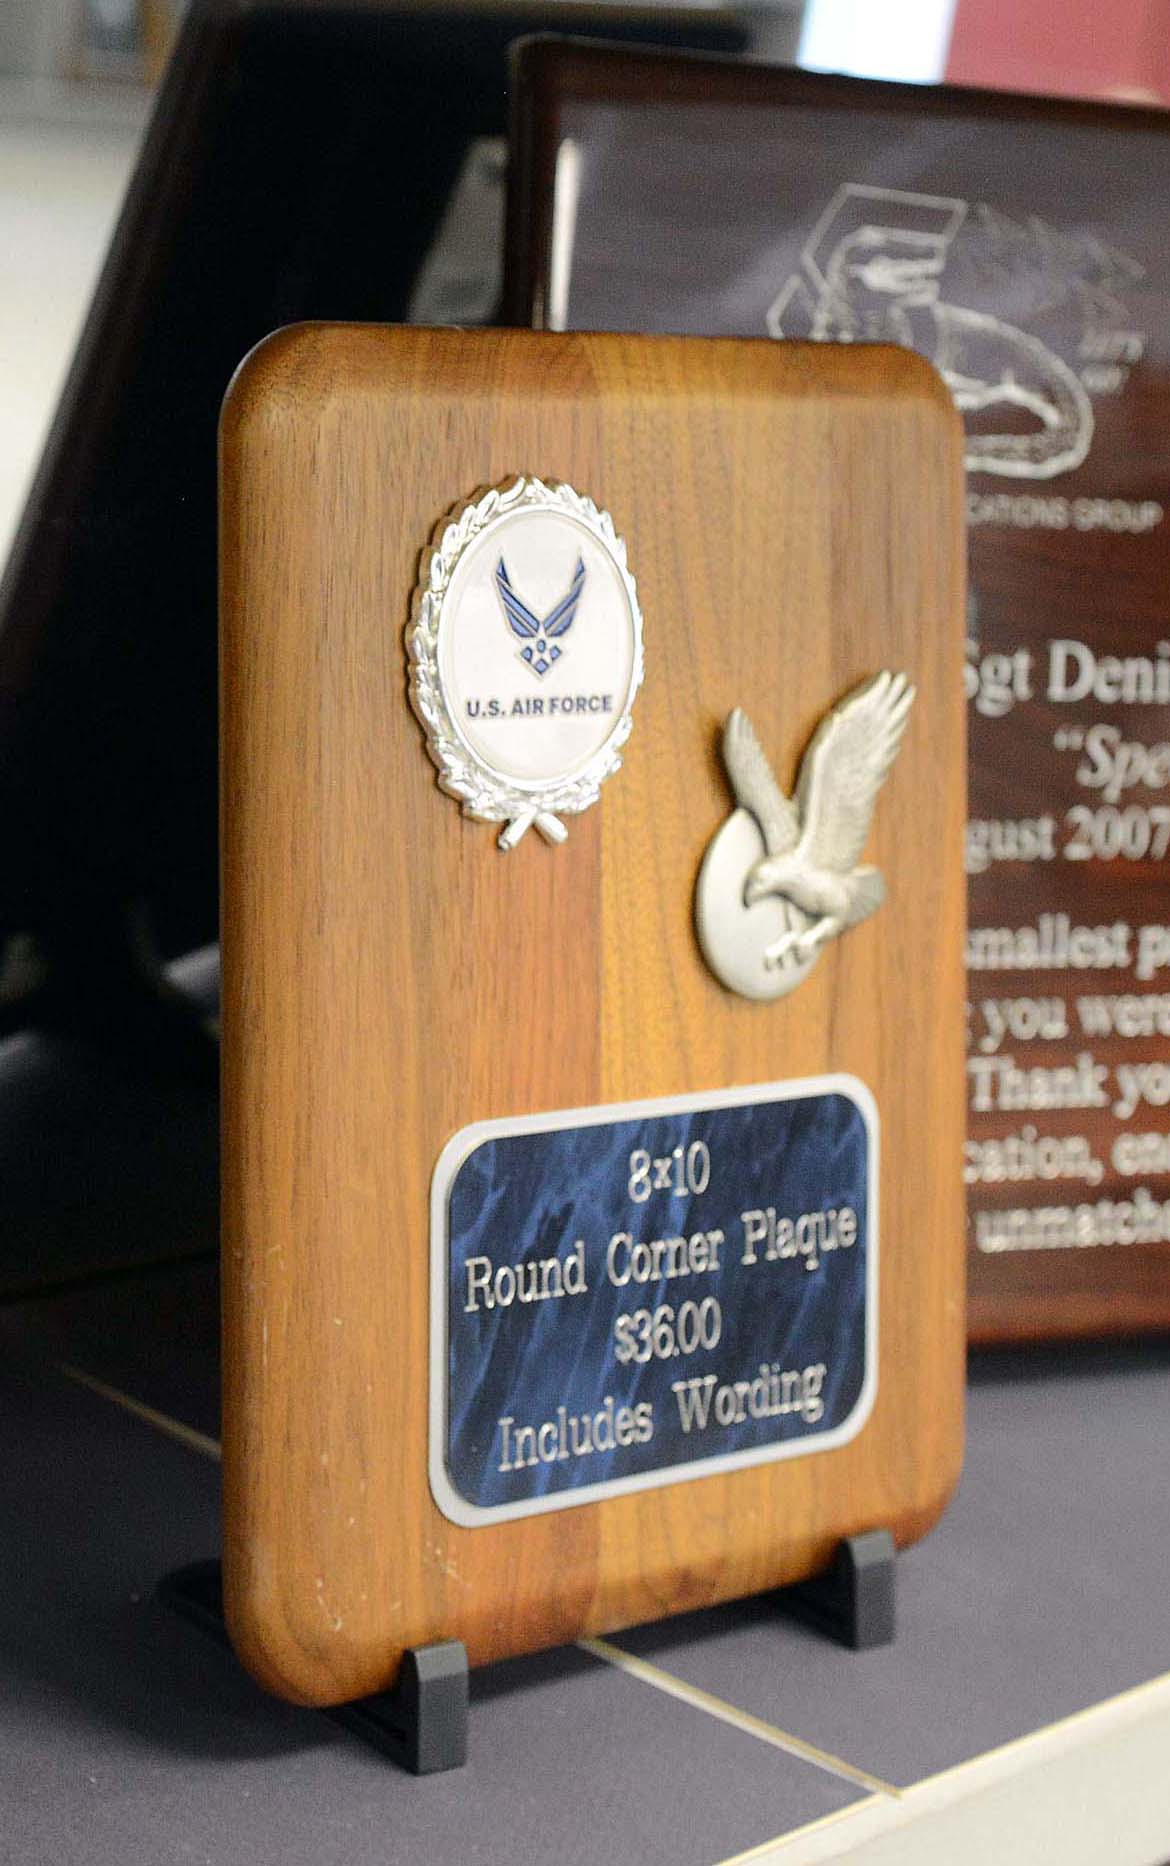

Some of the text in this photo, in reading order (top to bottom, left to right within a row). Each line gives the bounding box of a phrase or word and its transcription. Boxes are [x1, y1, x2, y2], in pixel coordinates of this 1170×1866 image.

[466, 695, 613, 718] U.S. AIR FORCE
[964, 911, 1132, 971] mallest
[978, 997, 1069, 1053] you
[968, 1052, 1110, 1112] Thank
[627, 1139, 711, 1204] 8x10
[463, 1204, 859, 1314] Round Corner Plaque
[612, 1296, 722, 1366] $36.00
[497, 1361, 828, 1473] Includes Wording
